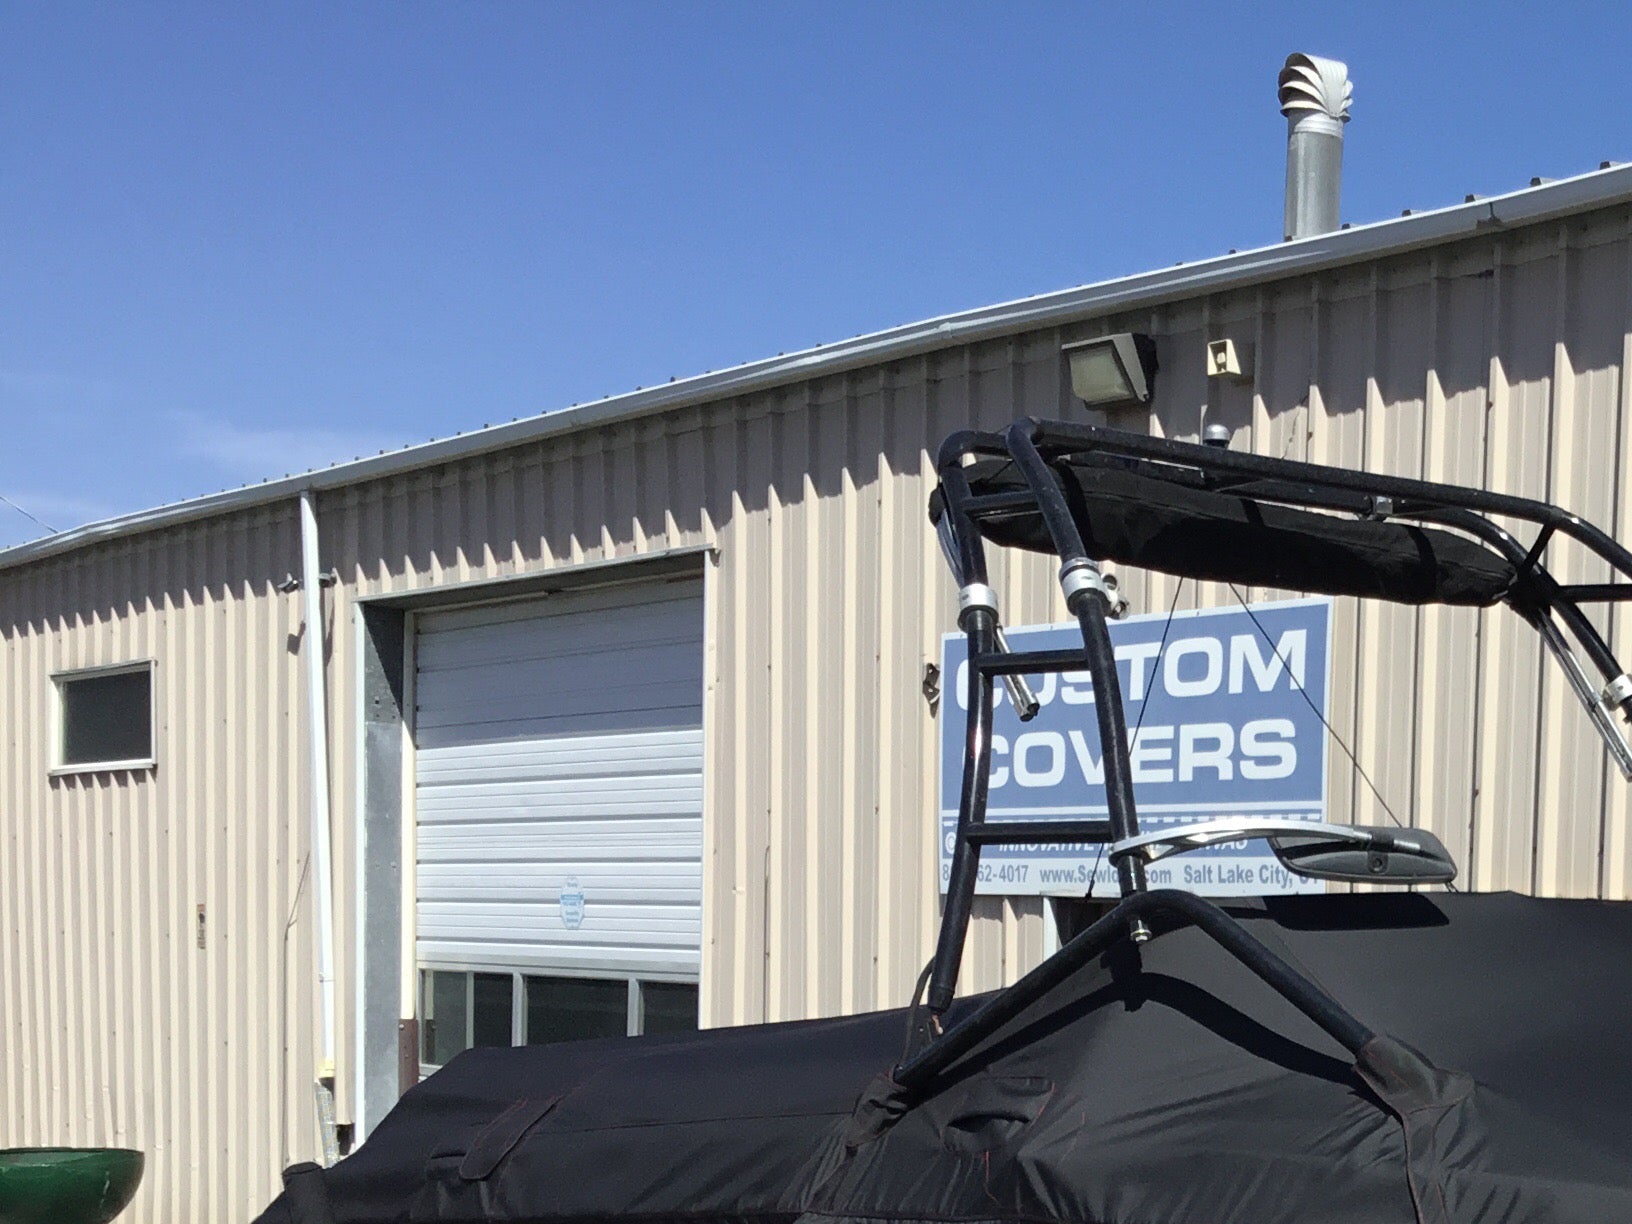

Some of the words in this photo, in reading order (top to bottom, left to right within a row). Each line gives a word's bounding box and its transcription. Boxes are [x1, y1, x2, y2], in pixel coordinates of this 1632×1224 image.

[1184, 864, 1213, 884] Salt
[1217, 864, 1254, 884] Lake
[1258, 864, 1294, 889] City,
